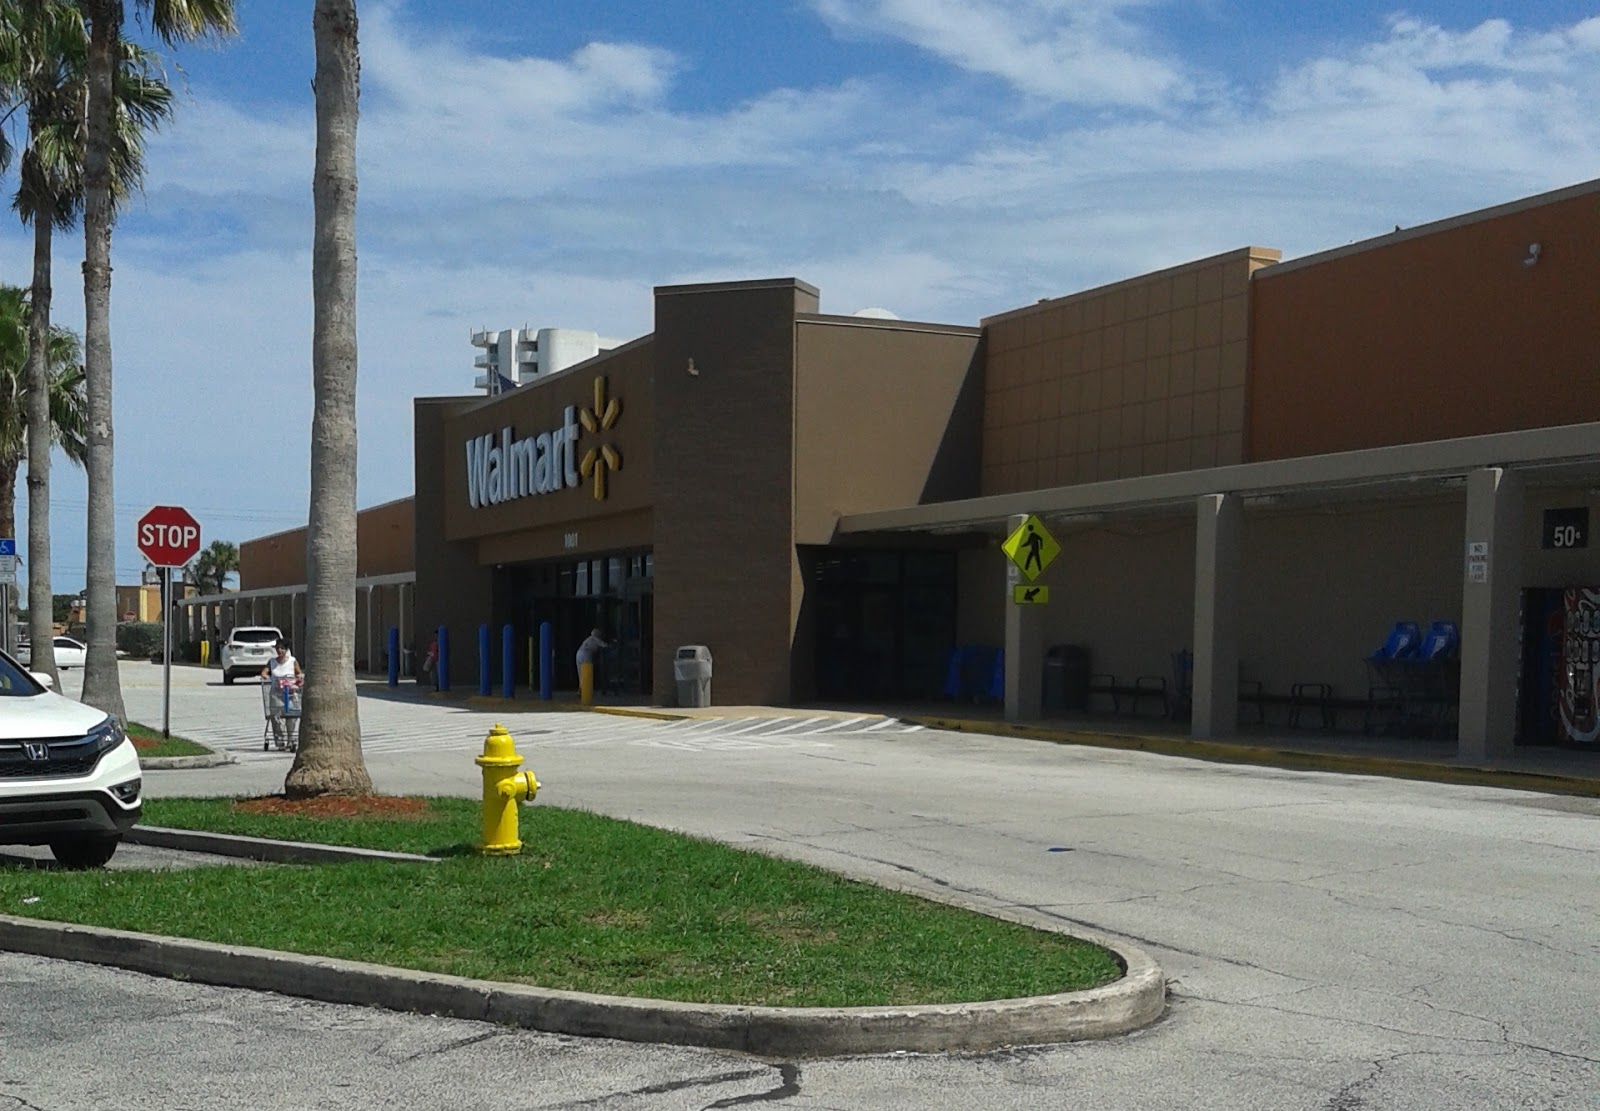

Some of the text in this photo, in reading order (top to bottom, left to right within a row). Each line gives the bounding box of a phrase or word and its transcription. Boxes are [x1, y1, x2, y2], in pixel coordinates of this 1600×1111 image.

[465, 406, 580, 509] Walmart
[141, 523, 197, 548] STOP
[1473, 544, 1483, 553] NO
